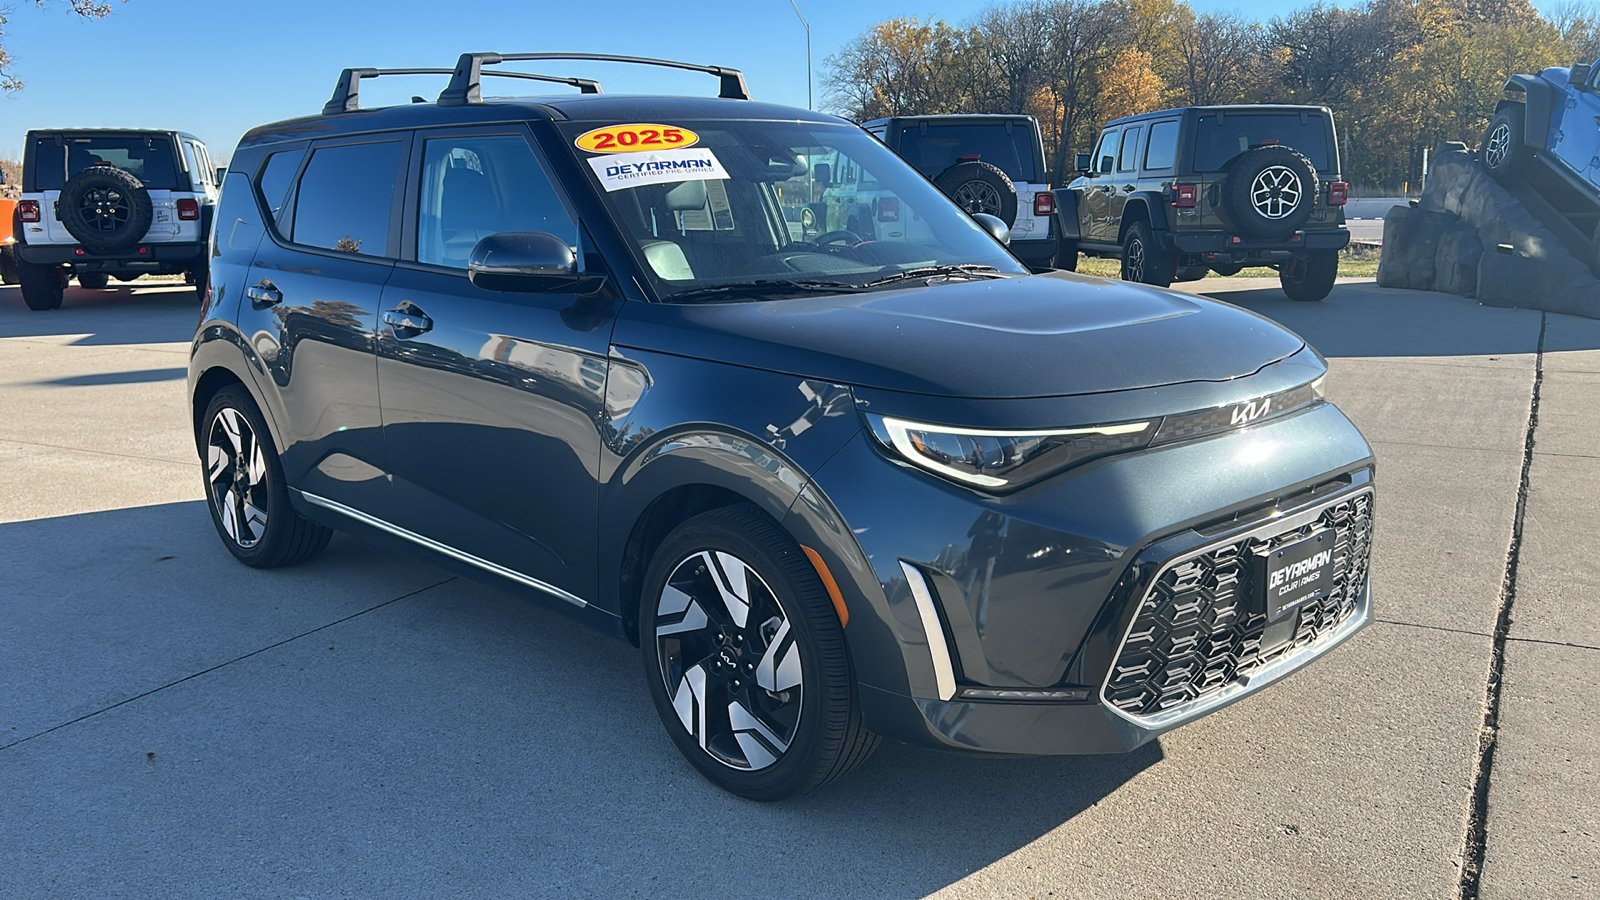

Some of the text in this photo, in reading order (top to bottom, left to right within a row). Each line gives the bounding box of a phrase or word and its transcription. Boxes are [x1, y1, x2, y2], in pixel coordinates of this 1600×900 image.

[593, 129, 684, 149] 2025
[606, 159, 712, 177] DEYARMAN
[617, 167, 715, 180] CERTIFIED PRE-OWNED
[1269, 549, 1332, 590] DEYARMAN
